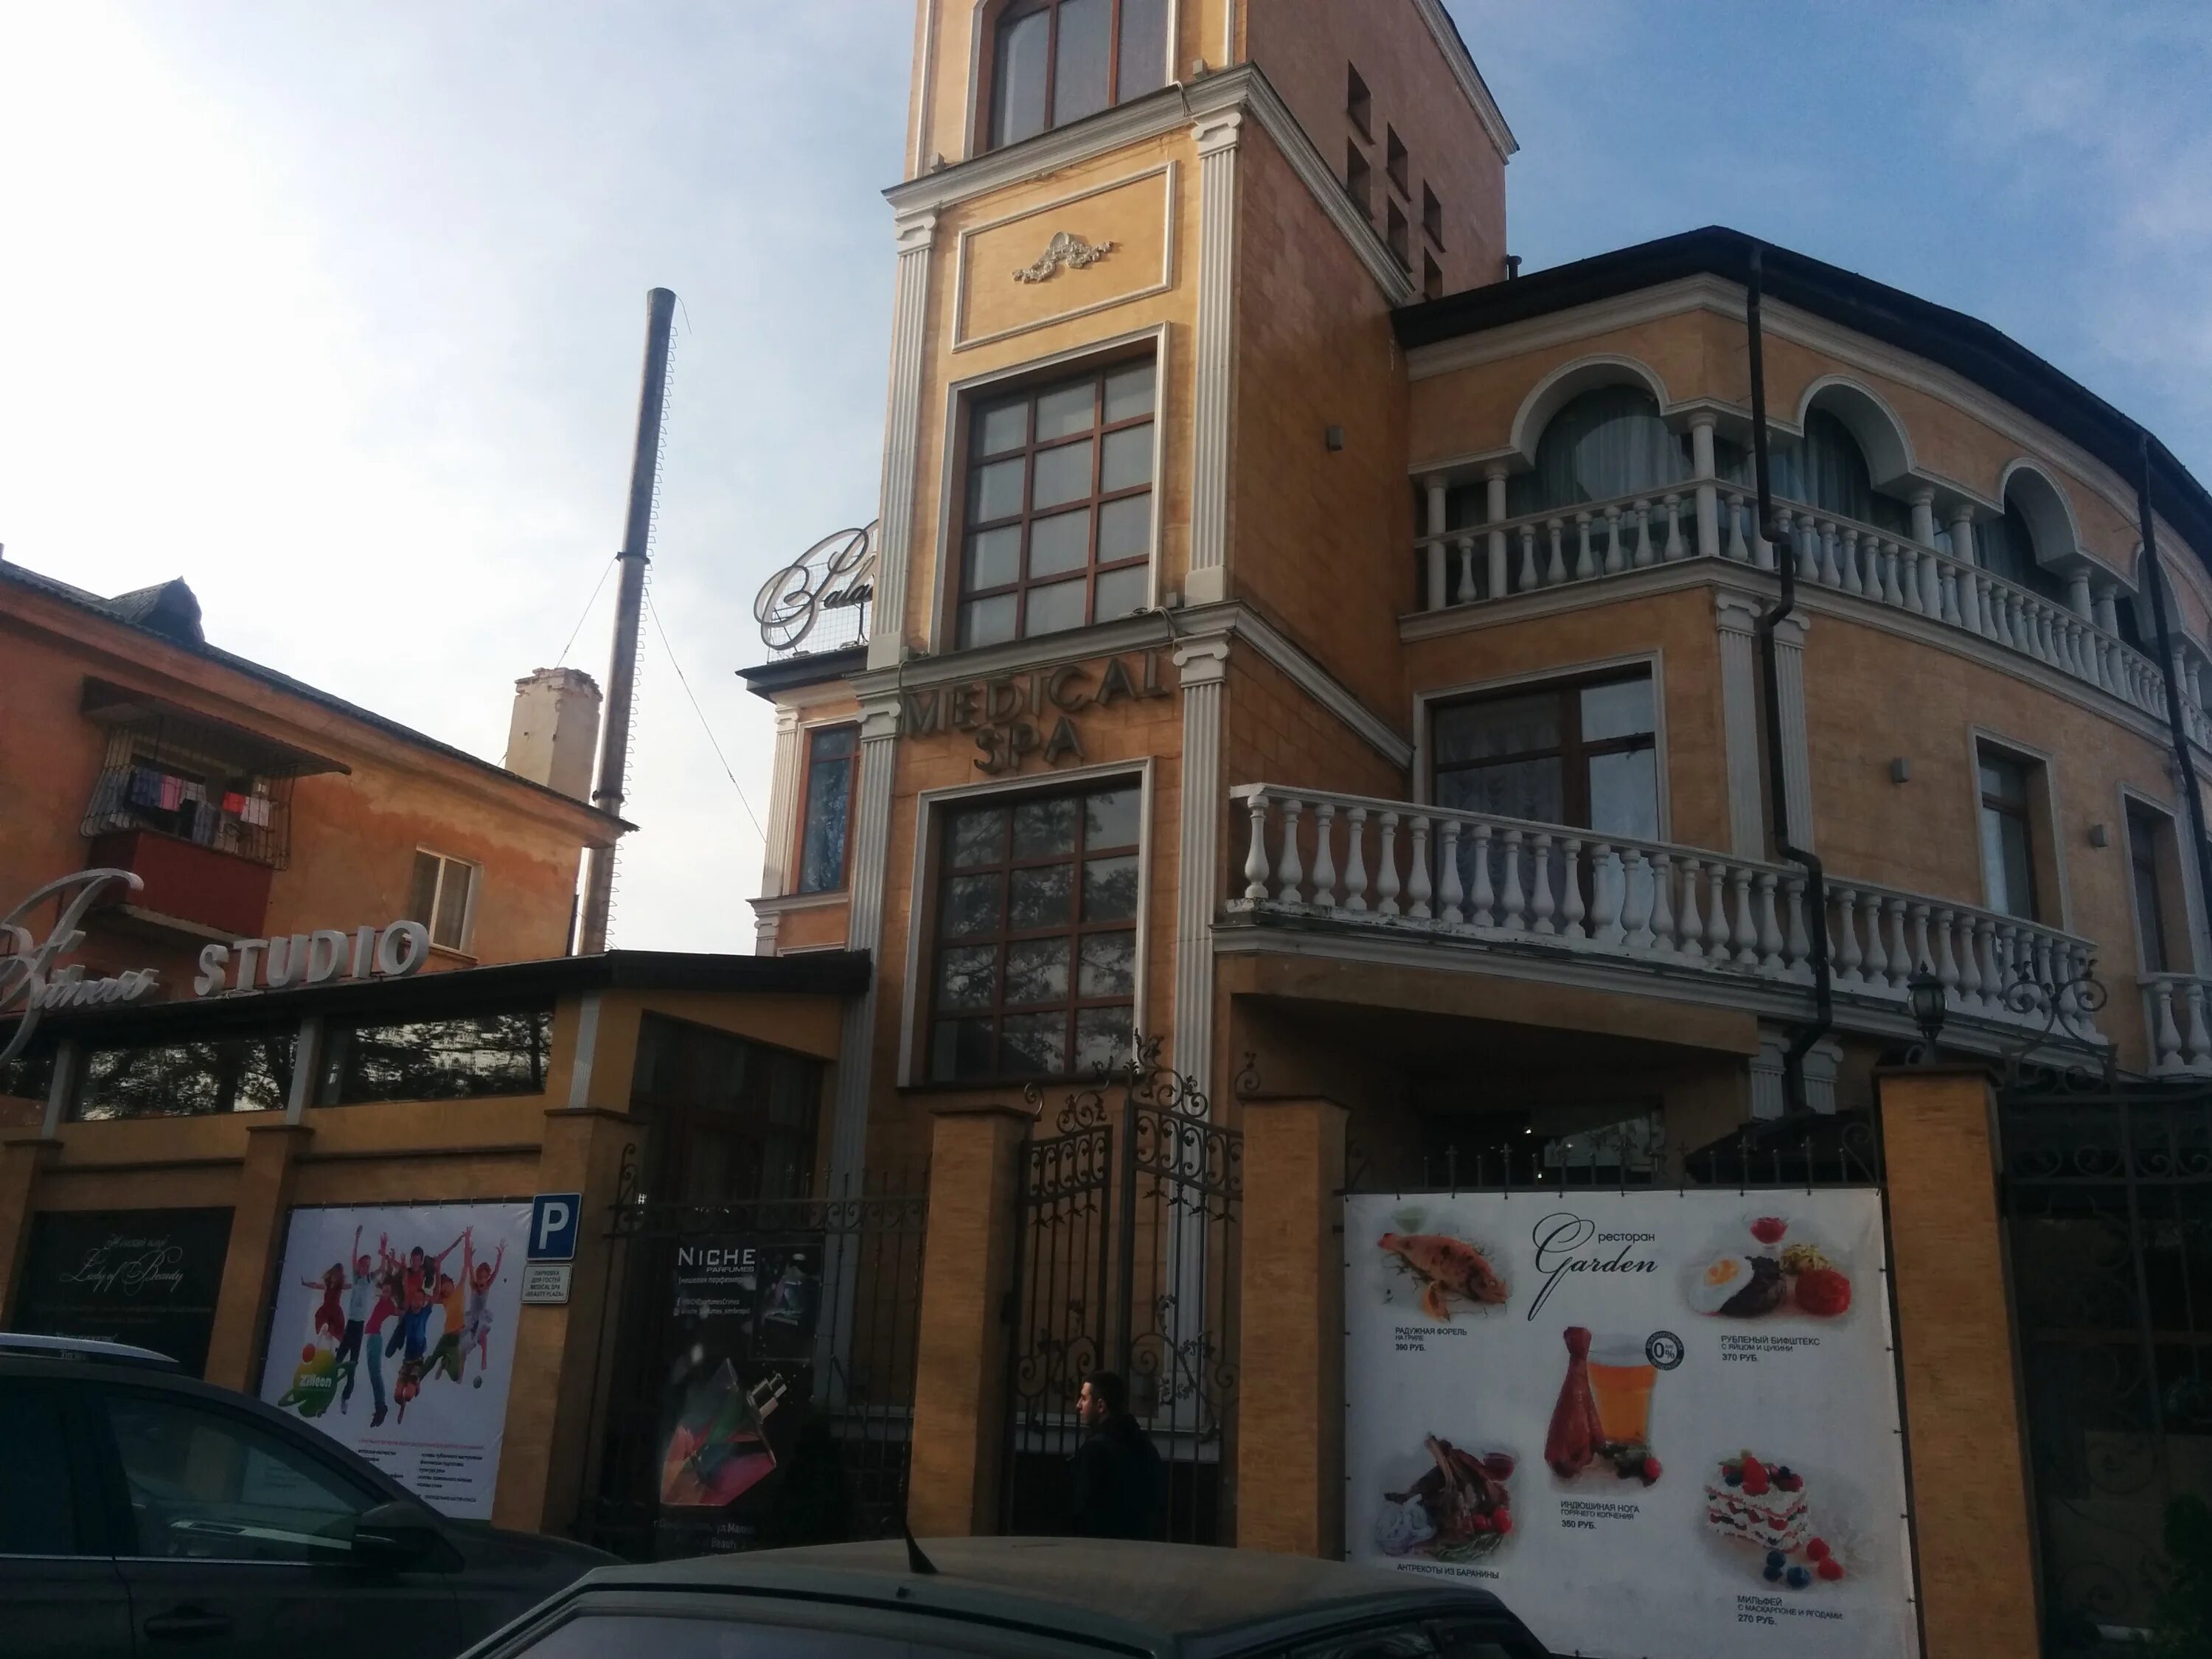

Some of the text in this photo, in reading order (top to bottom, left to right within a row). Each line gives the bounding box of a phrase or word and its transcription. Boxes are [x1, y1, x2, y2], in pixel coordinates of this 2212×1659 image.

[900, 650, 1172, 737] MEDICAL
[973, 715, 1086, 774] SPA
[194, 920, 429, 995] STUDIO
[538, 1202, 570, 1250] P
[1598, 1233, 1655, 1244] ресторан
[678, 1247, 756, 1266] NICHE
[59, 1248, 111, 1292] Lady
[1528, 1212, 1658, 1321] Garden
[1721, 1335, 1820, 1346] РУБЛЕНЫЙ БИФШТЕКС
[1722, 1353, 1737, 1361] 370
[1561, 1501, 1640, 1513] ИНДЮШИНАЯ НОГА
[1561, 1509, 1634, 1520] ГОРЯЧЕГО КОПЧЕНИЯ
[1578, 1521, 1597, 1529] РУБ.
[1397, 1564, 1499, 1579] АНТРЕКОТЫ ИЗ БАРАНИНЫ
[1737, 1596, 1783, 1606] МИЛЬФЕЙ
[1738, 1614, 1777, 1625] 270 РУБ.
[1745, 1604, 1796, 1615] МАСКАРПОНЕ
[1806, 1610, 1843, 1620] ЯГОДАМИ
